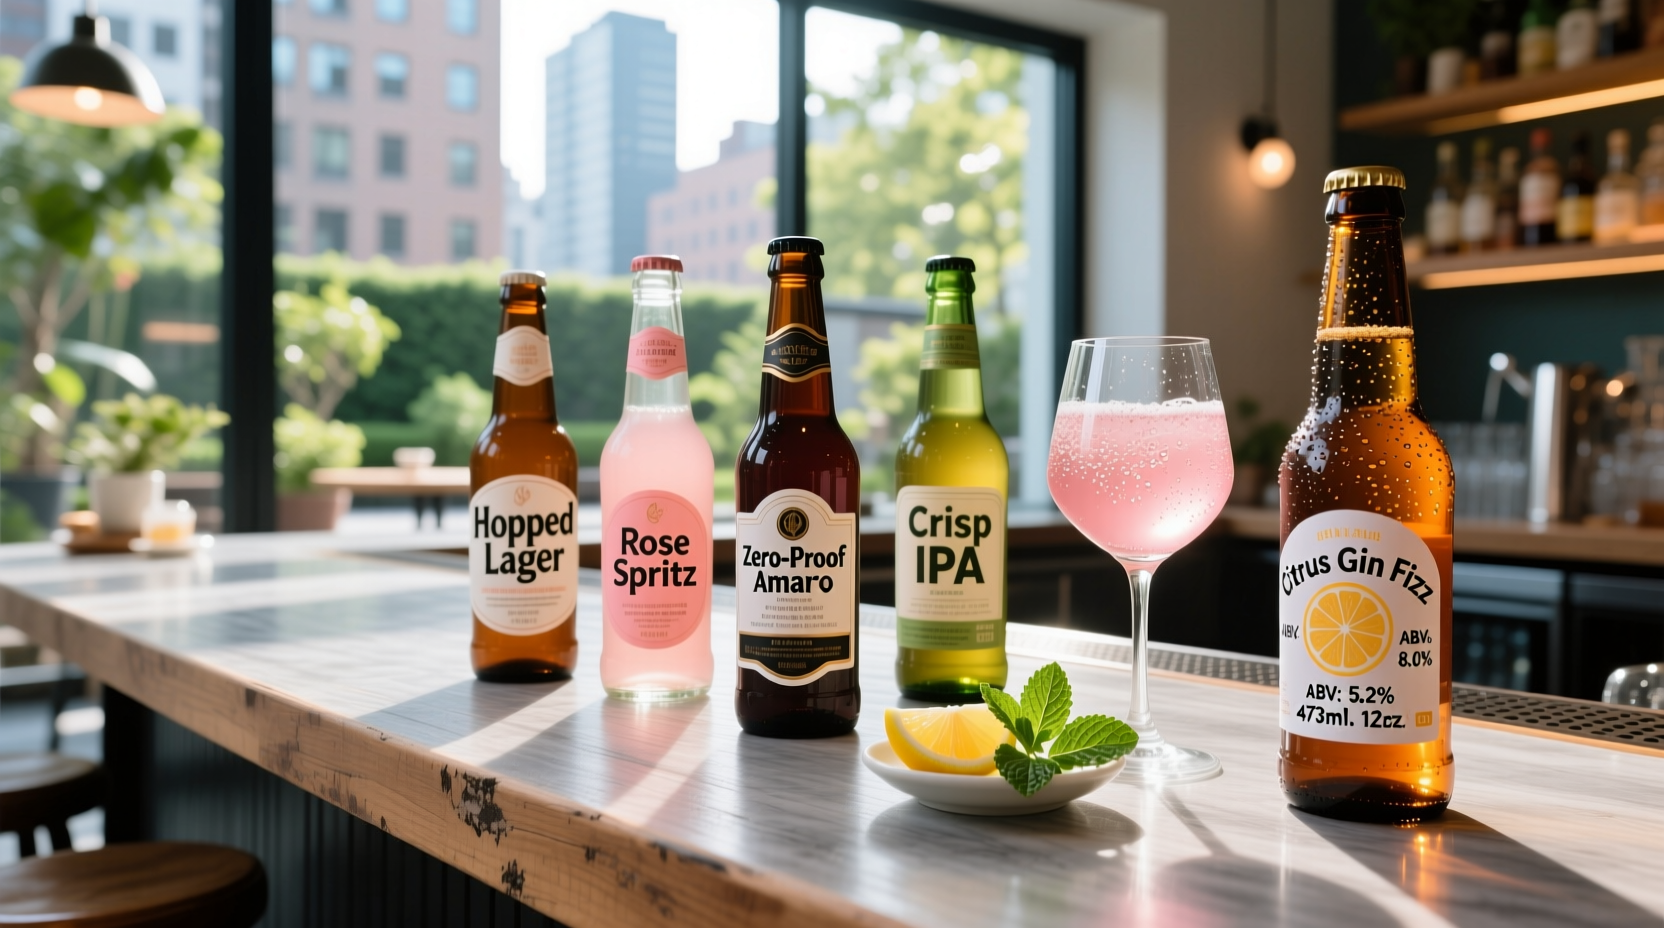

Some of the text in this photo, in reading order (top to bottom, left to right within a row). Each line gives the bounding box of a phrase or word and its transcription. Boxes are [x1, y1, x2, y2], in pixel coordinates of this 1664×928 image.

[474, 501, 573, 548] Hopped
[621, 527, 690, 556] Rose
[909, 505, 992, 547] Crisp
[485, 542, 565, 584] Lager
[742, 544, 847, 568] Zero-Proof
[916, 545, 985, 584] IPA
[613, 558, 697, 596] Spritz
[753, 570, 834, 594] Amaro
[1337, 547, 1384, 577] Gin
[1389, 557, 1434, 605] Fizz
[1306, 683, 1395, 705] ABV: 5.2%
[1296, 704, 1355, 727] 473ml.
